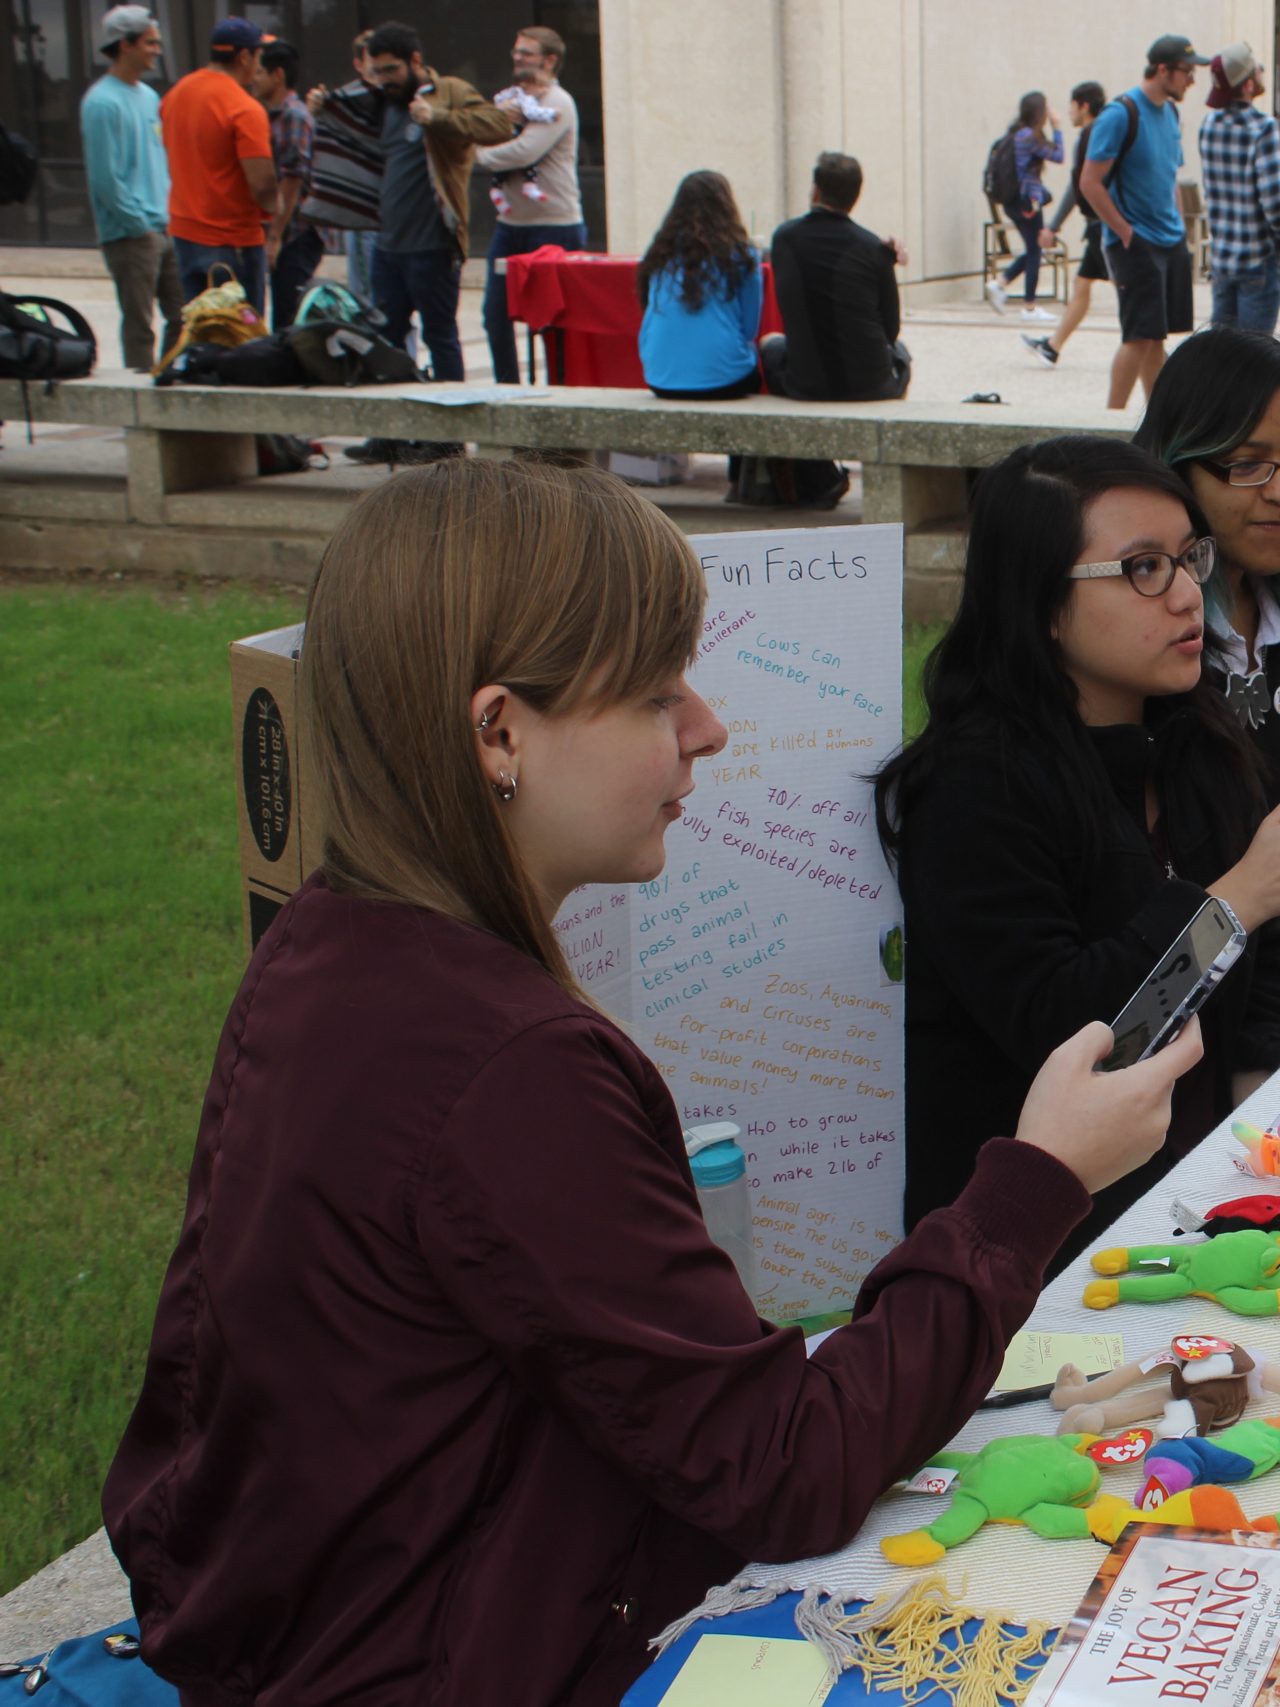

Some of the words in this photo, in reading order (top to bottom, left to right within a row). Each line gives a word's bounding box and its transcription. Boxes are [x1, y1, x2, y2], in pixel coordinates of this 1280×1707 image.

[700, 555, 751, 586] Fun
[765, 547, 868, 584] Facts
[703, 610, 727, 633] are
[756, 632, 800, 655] Cows
[811, 649, 841, 669] can
[737, 649, 811, 685] remember
[853, 693, 884, 718] face
[258, 725, 267, 754] cm
[271, 726, 282, 750] 28
[732, 742, 760, 758] are
[272, 754, 283, 770] in
[711, 764, 762, 786] YEAR
[260, 775, 271, 819] 101.6
[273, 788, 284, 812] 40
[811, 800, 841, 817] off
[843, 810, 867, 827] all
[263, 822, 272, 850] cm
[274, 816, 284, 832] in
[717, 801, 751, 828] fish
[763, 821, 816, 847] species
[829, 840, 858, 861] are
[682, 862, 700, 884] of
[639, 901, 691, 933] drugs
[698, 879, 740, 905] that
[639, 934, 676, 968] pass
[691, 901, 751, 938] animal
[641, 950, 714, 992] testing
[727, 924, 758, 949] fail
[772, 911, 788, 928] in
[645, 978, 709, 1019] clinical
[721, 938, 787, 978] studies
[764, 974, 813, 1000] Zoos,
[719, 995, 751, 1014] and
[846, 1024, 877, 1042] are
[653, 1031, 689, 1055] that
[700, 1048, 743, 1067] value
[751, 1058, 799, 1084] money
[809, 1071, 848, 1091] more
[856, 1079, 896, 1101] than
[782, 1039, 882, 1072] corporations
[655, 1061, 677, 1078] he
[689, 1070, 769, 1096] animals!
[684, 1104, 738, 1120] takes
[788, 1117, 809, 1129] to
[819, 1113, 858, 1131] grow
[780, 1141, 820, 1157] while
[833, 1135, 850, 1149] it
[859, 1130, 896, 1145] takes
[773, 1167, 815, 1183] make
[867, 1152, 884, 1170] of
[756, 1194, 801, 1216] Animal
[851, 1219, 866, 1234] is
[773, 1240, 806, 1262] them
[805, 1227, 828, 1246] The
[832, 1237, 848, 1253] US
[760, 1256, 797, 1278] lower
[802, 1270, 827, 1290] the
[1090, 1627, 1115, 1655] THE
[1110, 1604, 1128, 1629] JOY
[1122, 1586, 1138, 1605] OF
[1106, 1565, 1208, 1685] VEGAN
[1157, 1568, 1259, 1703] BAKING
[1214, 1665, 1233, 1691] The
[1230, 1610, 1262, 1675] Compassionate
[1248, 1637, 1270, 1668] Treats
[1264, 1619, 1278, 1638] and
